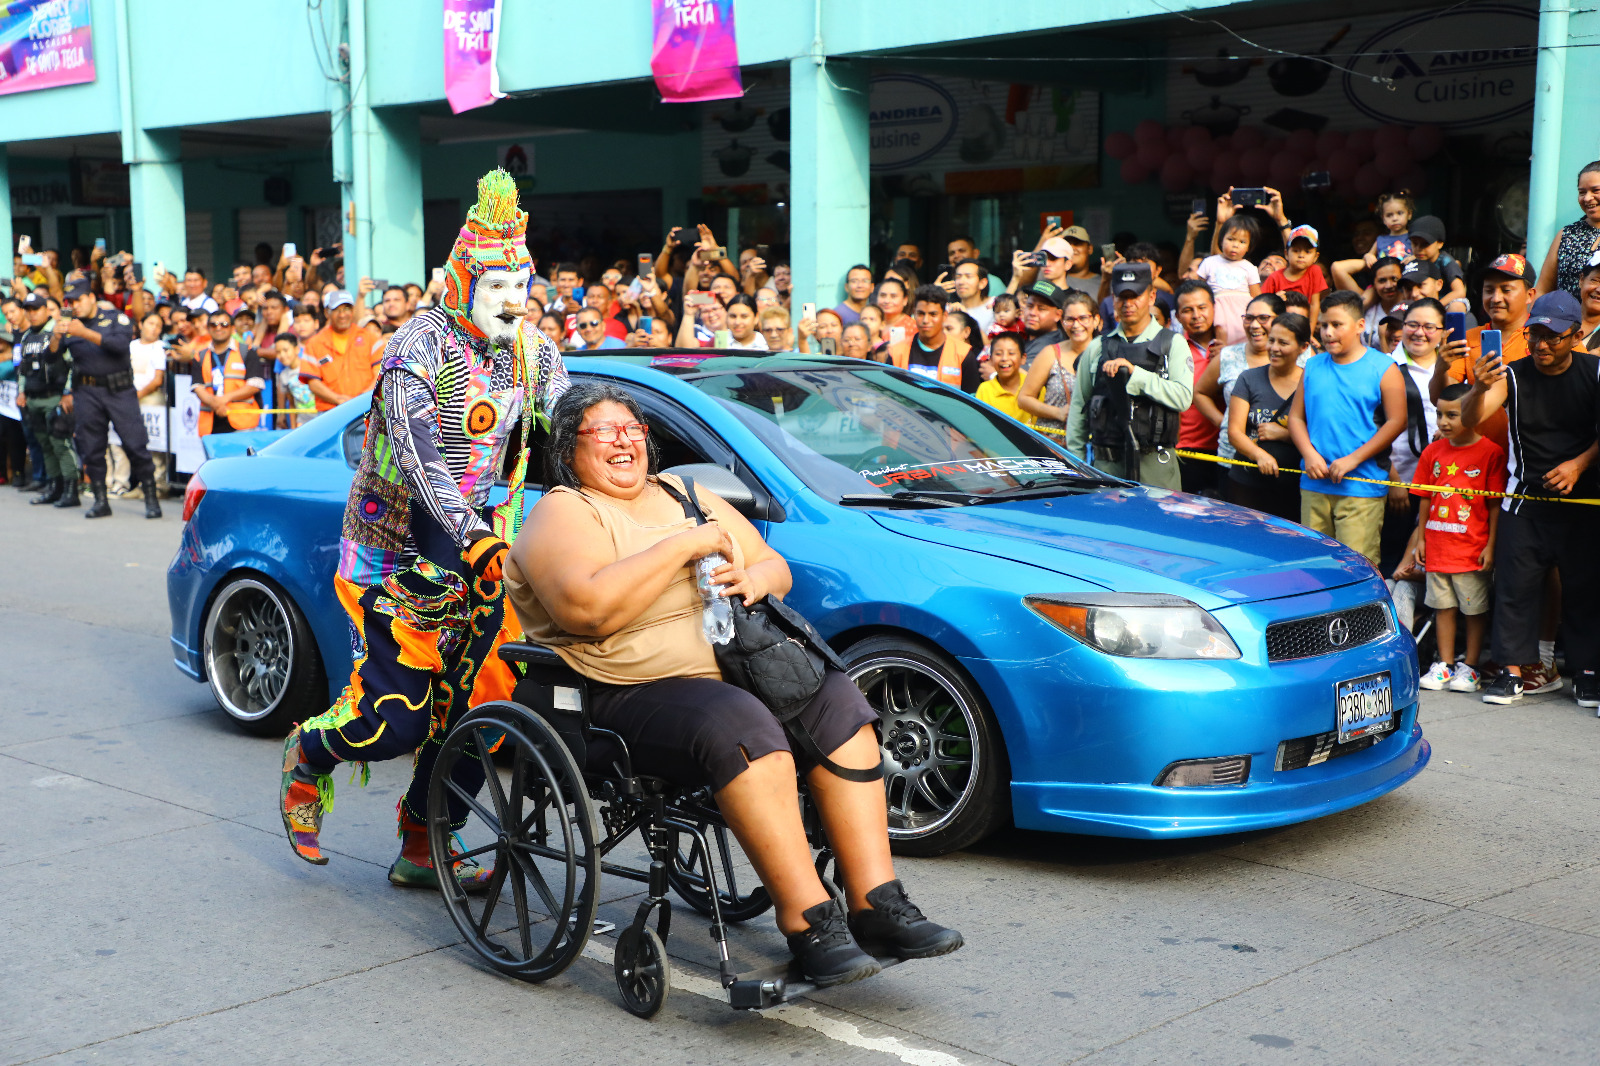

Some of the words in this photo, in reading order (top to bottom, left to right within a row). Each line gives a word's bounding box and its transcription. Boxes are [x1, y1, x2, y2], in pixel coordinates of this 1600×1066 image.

[28, 15, 72, 40] FLORES
[444, 10, 467, 32] DE
[32, 34, 72, 51] ALCALDE
[1415, 77, 1514, 103] Cuisine
[870, 130, 921, 149] uisine
[859, 463, 908, 478] President
[866, 465, 967, 487] URBAN
[963, 459, 1067, 472] MACHINE
